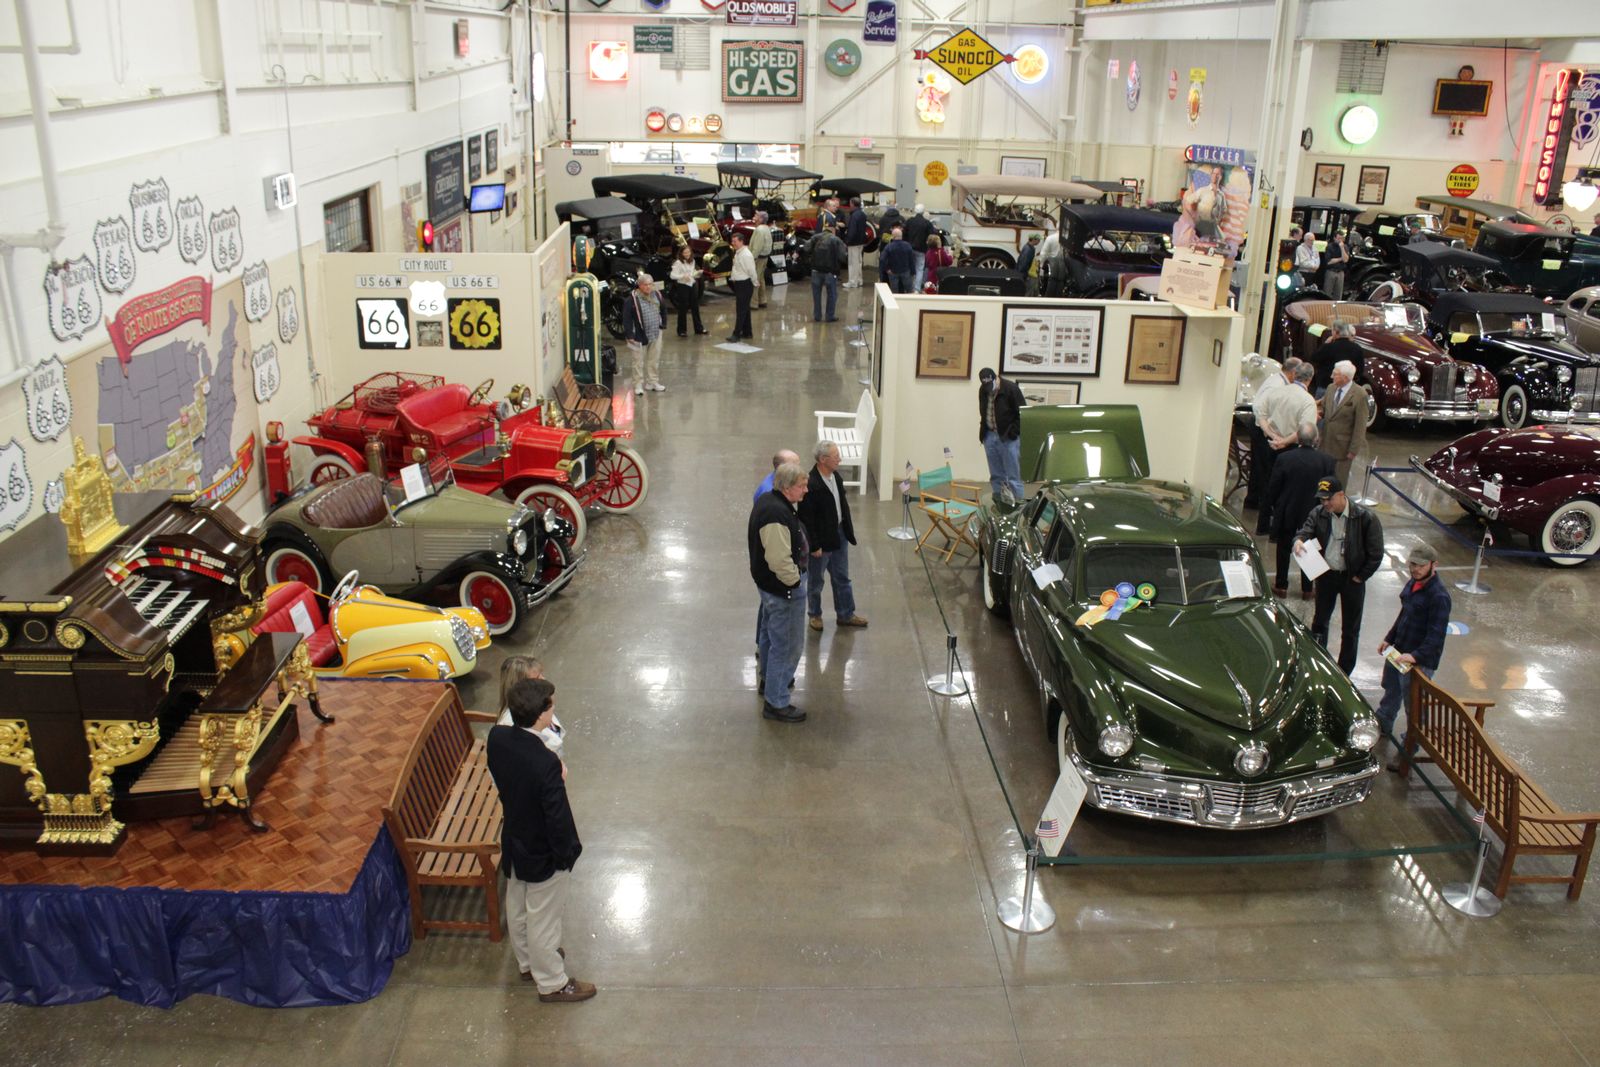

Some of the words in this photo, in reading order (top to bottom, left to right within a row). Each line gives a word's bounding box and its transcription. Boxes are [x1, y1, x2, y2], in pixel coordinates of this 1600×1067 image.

[727, 1, 795, 14] OLDSMOBILE
[865, 22, 895, 36] Service
[958, 38, 975, 47] GAS
[729, 51, 796, 68] HI-SPEED
[938, 48, 994, 65] SUNOCO
[729, 68, 796, 96] GAS
[957, 67, 972, 76] OIL
[1196, 148, 1240, 164] TUCKER
[1535, 102, 1563, 196] HUDSON
[132, 187, 167, 209] BUSINESS
[142, 206, 167, 243] 66
[212, 215, 237, 234] KANSAS
[100, 228, 127, 249] TEXAS
[183, 221, 204, 255] 66
[219, 231, 237, 264] 66
[105, 244, 132, 285] 66
[404, 260, 421, 271] CITY
[424, 260, 447, 271] ROUTE
[360, 276, 375, 287] US
[379, 276, 391, 287] 66
[395, 277, 402, 286] W
[452, 277, 466, 288] US
[470, 277, 483, 288] 66
[487, 277, 492, 287] E
[62, 287, 92, 331] 66
[250, 283, 267, 316] 66
[418, 300, 439, 311] 66
[124, 320, 137, 345] OF
[137, 307, 168, 336] ROUTE
[169, 301, 180, 322] 66
[181, 295, 203, 316] SIGNS
[281, 305, 296, 338] 66
[368, 310, 399, 335] 66
[459, 310, 491, 338] 66
[32, 368, 60, 396] ARIZ.
[260, 364, 275, 396] 66
[36, 388, 67, 434] 66
[210, 465, 245, 500] AMERICA
